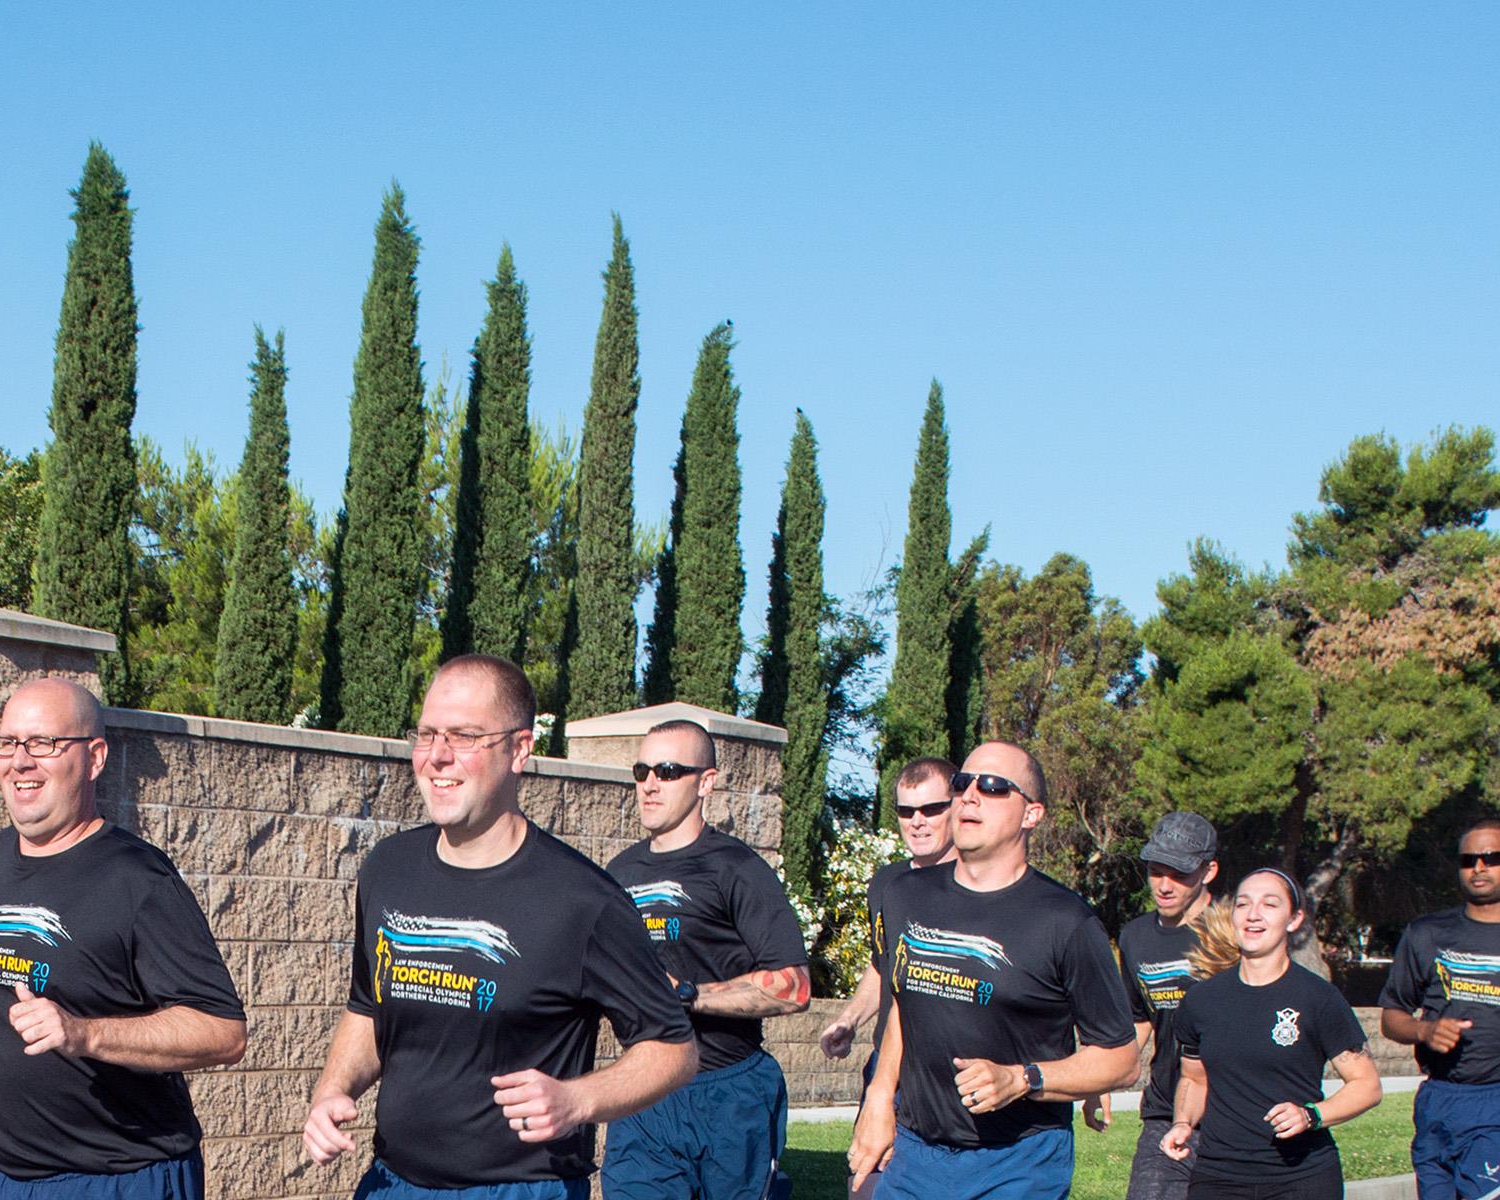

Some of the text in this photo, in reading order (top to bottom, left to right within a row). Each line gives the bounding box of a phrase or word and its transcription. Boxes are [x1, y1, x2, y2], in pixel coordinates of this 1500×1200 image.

[408, 960, 453, 971] ENFORCEMENT
[391, 983, 471, 1001] FOR SPECIAL OLYMPICS
[477, 978, 497, 997] 20
[391, 991, 471, 1008] NORTHERN CALIFORNIA
